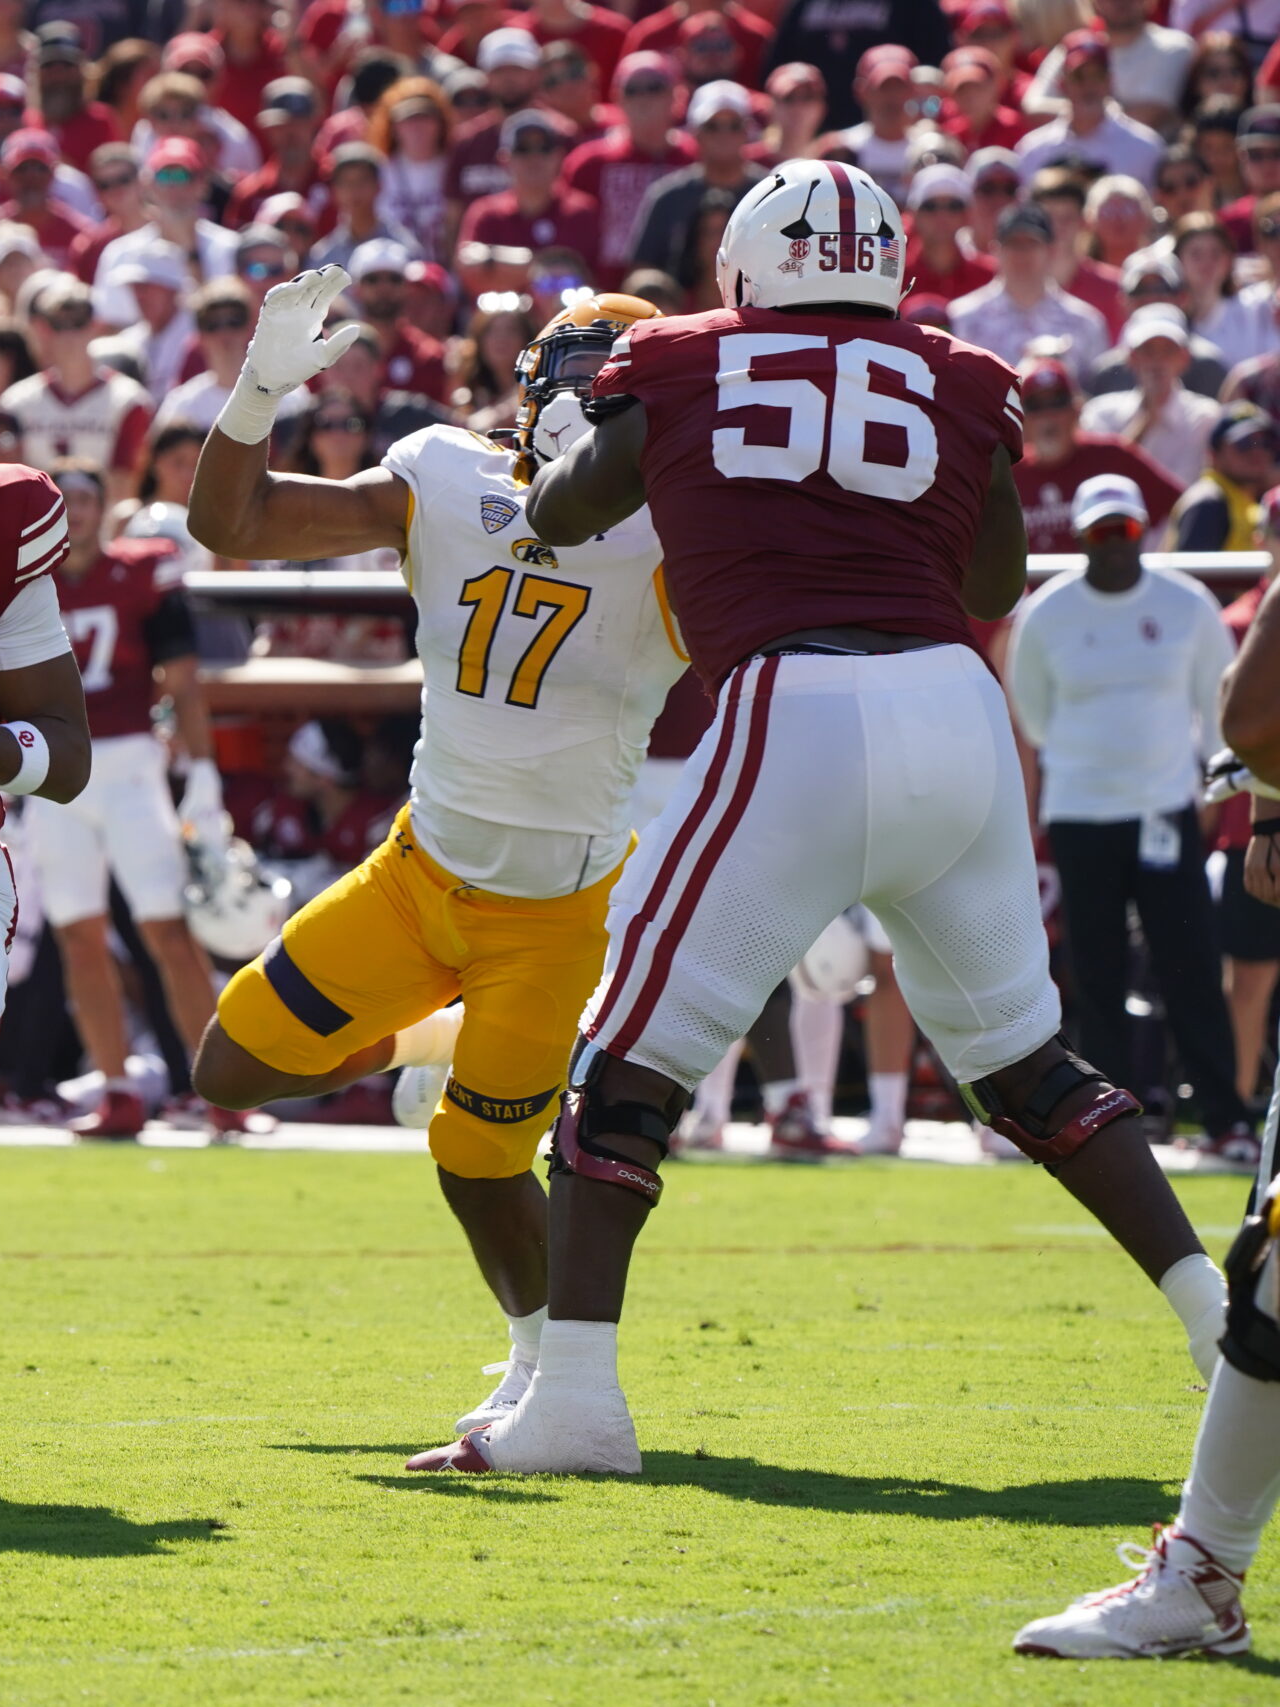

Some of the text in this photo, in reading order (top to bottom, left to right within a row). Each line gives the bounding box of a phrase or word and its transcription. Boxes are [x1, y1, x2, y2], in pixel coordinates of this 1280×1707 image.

[789, 240, 810, 260] SEC
[819, 235, 874, 272] 56
[712, 333, 939, 503] 56
[481, 509, 512, 525] MAC
[456, 565, 592, 710] 17
[481, 1101, 533, 1119] STATE
